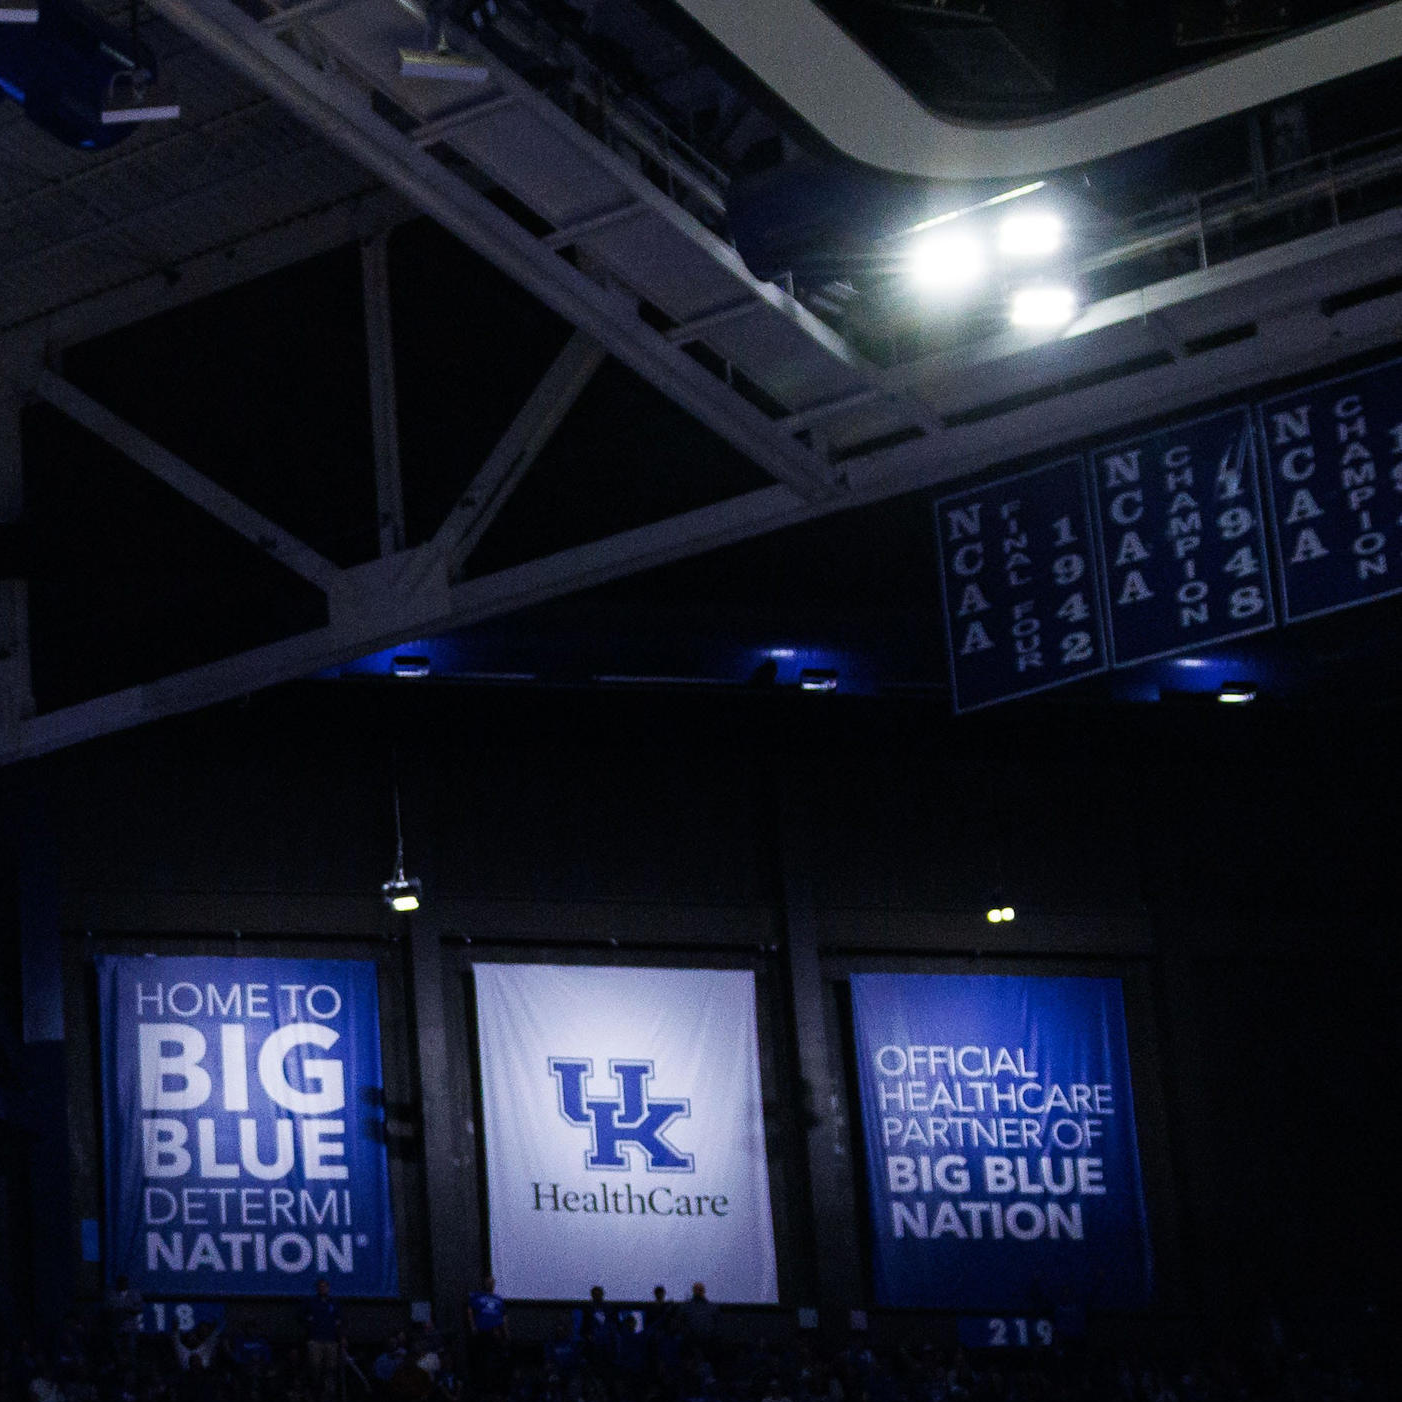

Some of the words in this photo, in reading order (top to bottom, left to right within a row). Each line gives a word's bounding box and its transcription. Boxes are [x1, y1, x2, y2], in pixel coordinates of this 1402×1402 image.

[1103, 449, 1153, 605] NCAA
[1163, 445, 1210, 627] CHAMPION
[946, 503, 994, 656] NCAA
[1050, 515, 1095, 665] 1942
[135, 981, 270, 1018] HOME
[280, 984, 342, 1020] TO
[137, 1022, 346, 1115] BIG
[873, 1045, 1039, 1079] OFFICIAL
[546, 1055, 696, 1174] UK
[877, 1082, 1115, 1115] HEALTHCARE
[140, 1118, 350, 1180] BLUE
[882, 1118, 1043, 1150] PARTNER
[1052, 1119, 1103, 1152] OF
[886, 1155, 972, 1194] BIG
[983, 1157, 1107, 1196] BLUE
[143, 1187, 353, 1227] DETERMI
[531, 1181, 730, 1219] HealthCare
[892, 1201, 1084, 1241] NATION
